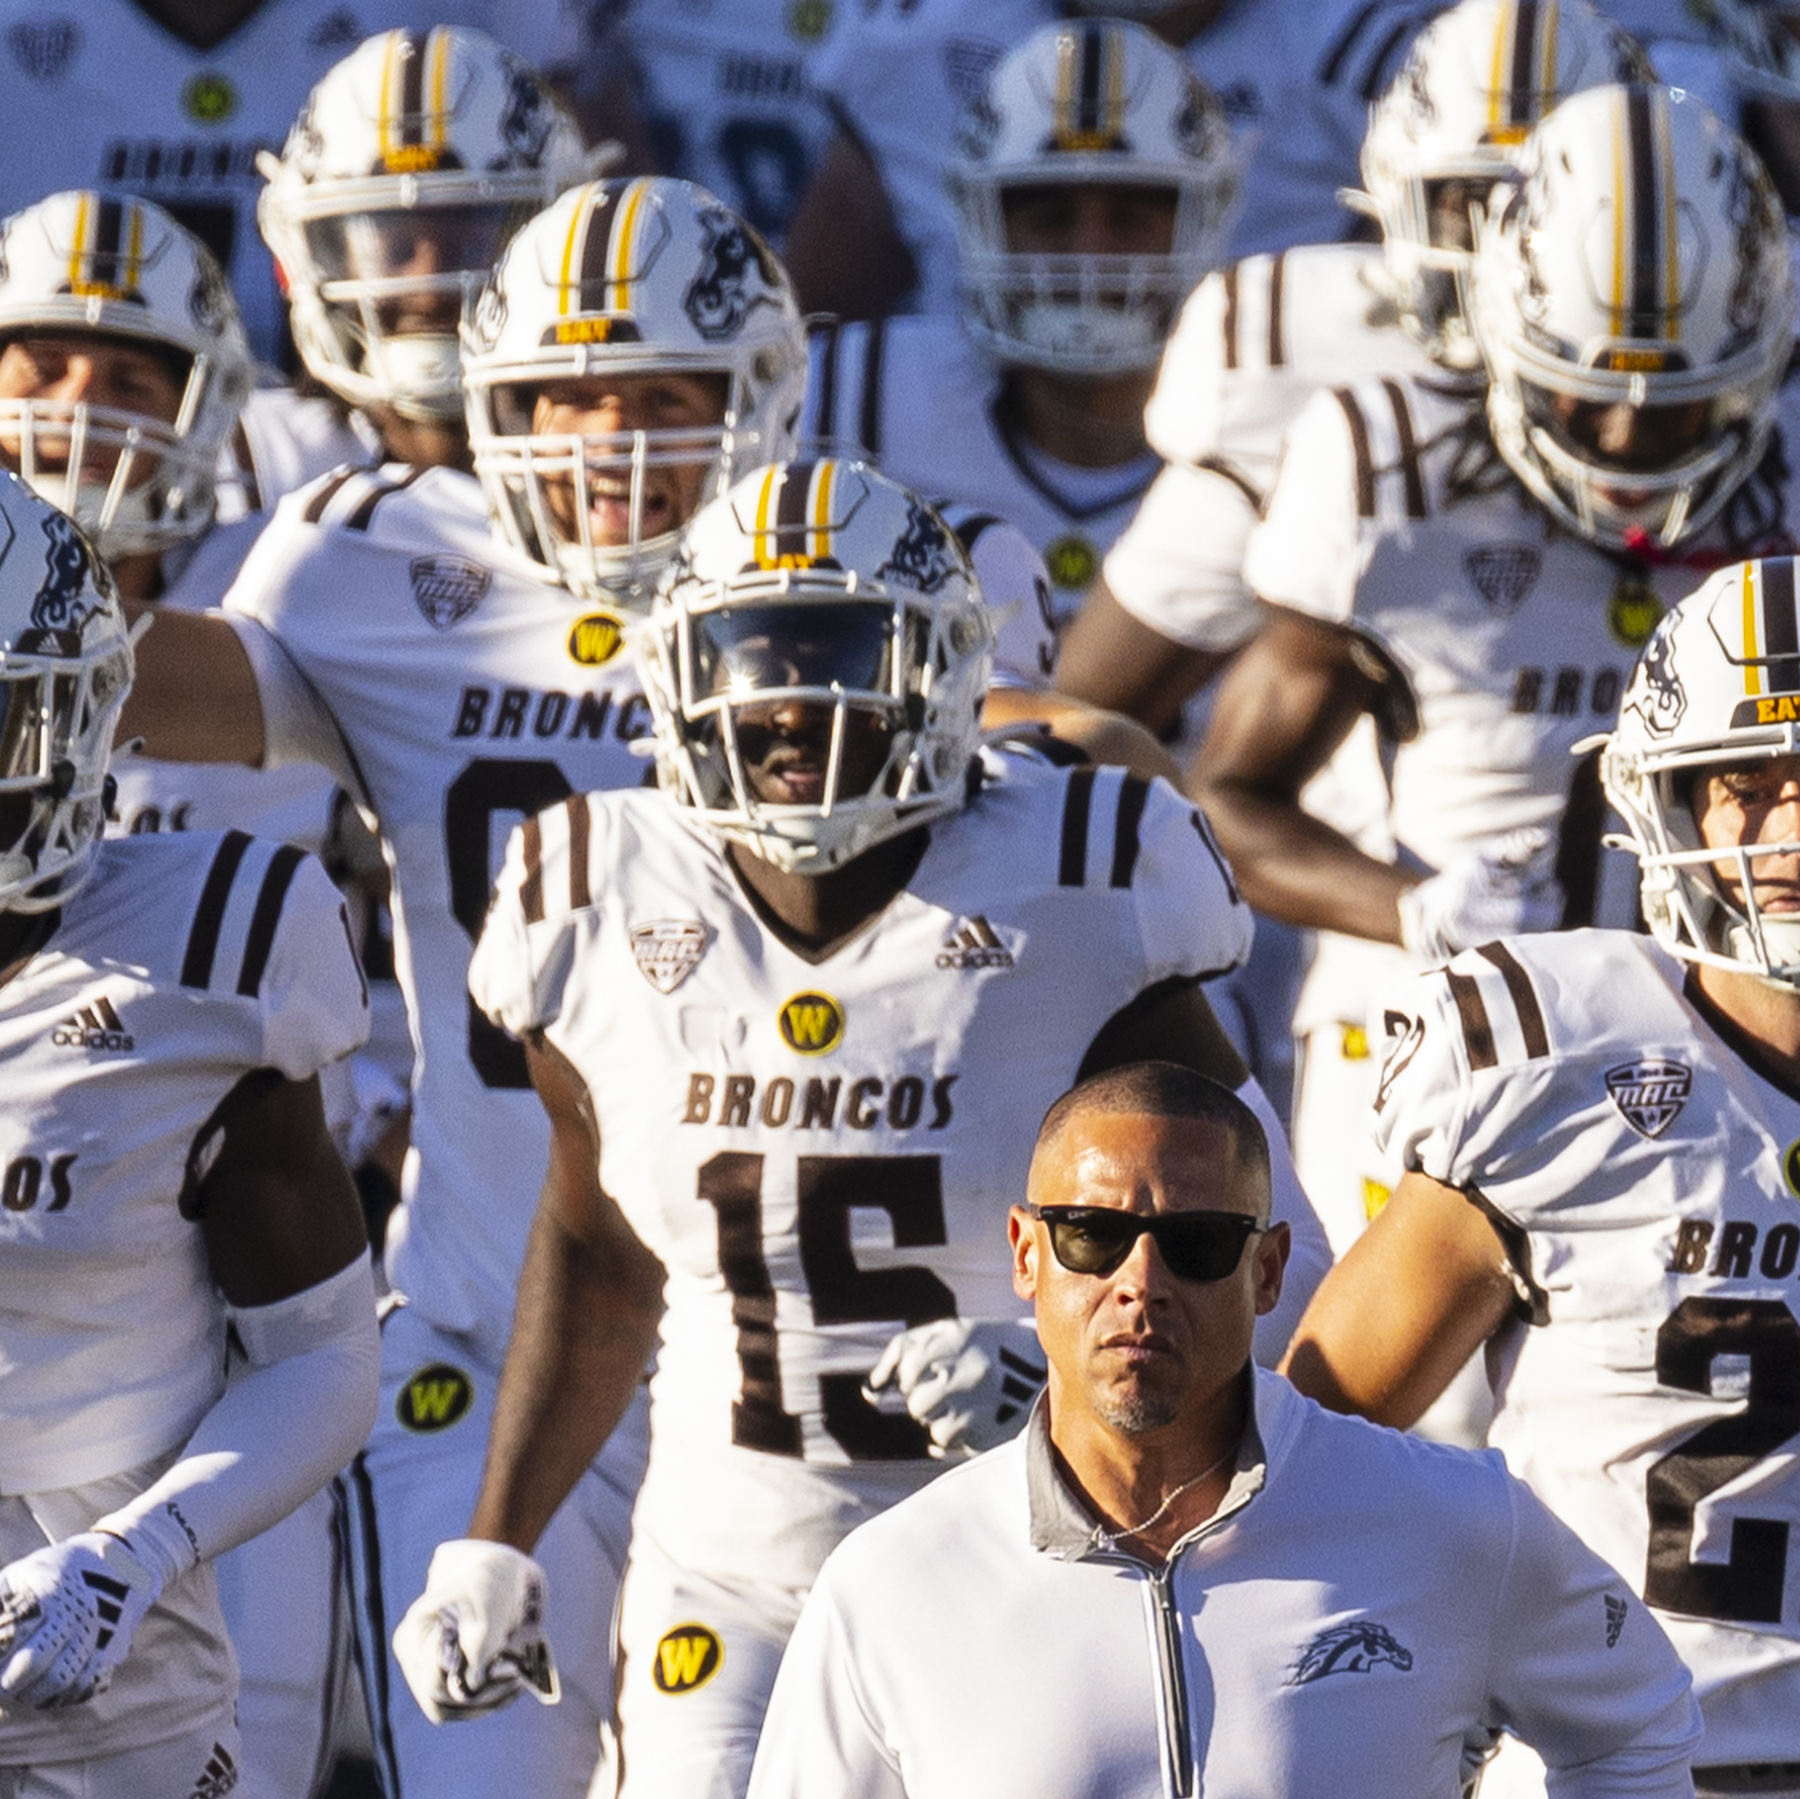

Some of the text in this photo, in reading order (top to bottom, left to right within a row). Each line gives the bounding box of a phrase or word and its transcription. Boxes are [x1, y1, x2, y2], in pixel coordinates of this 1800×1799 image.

[52, 1029, 135, 1052] adidas
[787, 1006, 828, 1045] W
[682, 1072, 958, 1130] BRONCOS
[1613, 1080, 1688, 1107] MAC
[697, 1148, 966, 1461] 15
[409, 1381, 460, 1421] W
[659, 1636, 712, 1688] W
